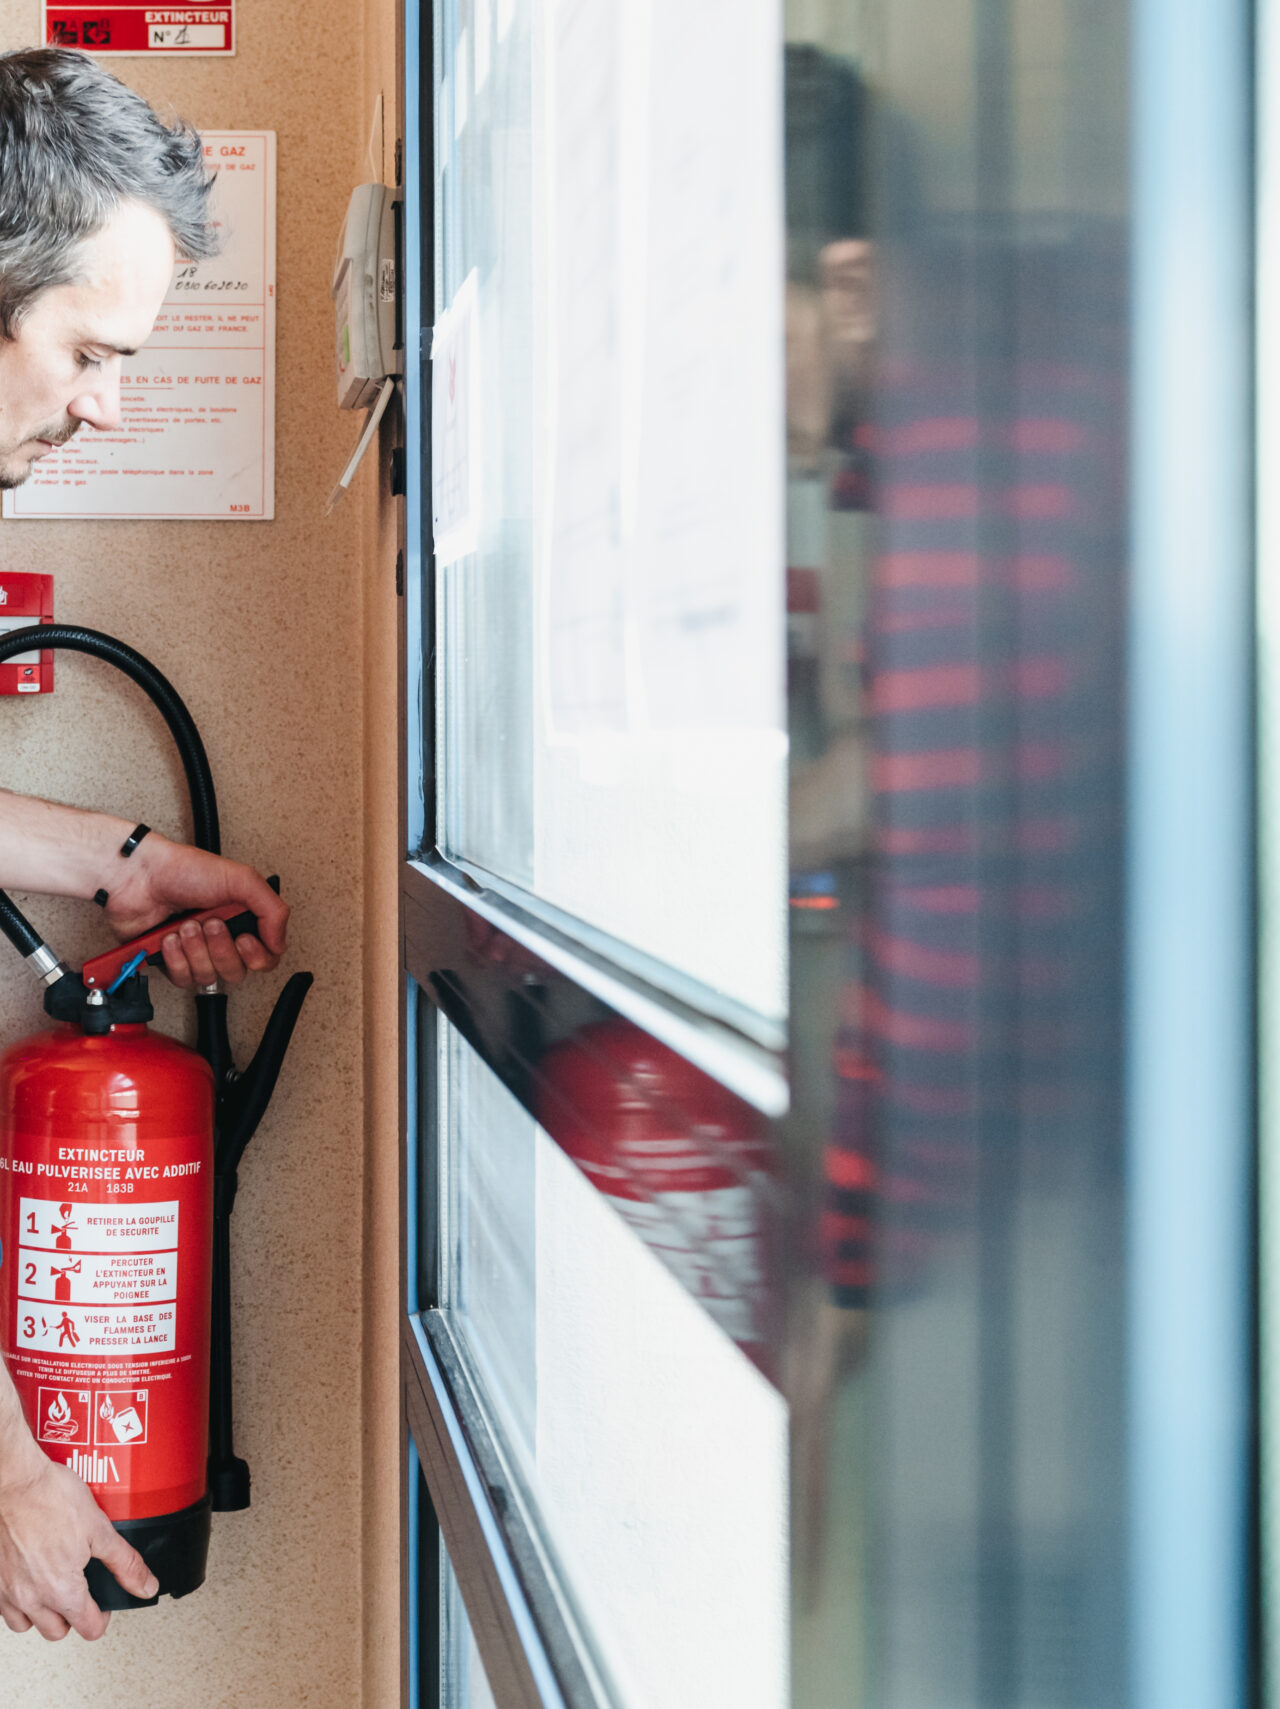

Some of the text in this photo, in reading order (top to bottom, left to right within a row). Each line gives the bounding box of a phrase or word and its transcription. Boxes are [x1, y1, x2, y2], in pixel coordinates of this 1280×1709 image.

[145, 11, 229, 23] EXTINCTEUR
[154, 31, 171, 43] N°
[220, 146, 246, 157] GAZ
[177, 266, 198, 278] 18
[120, 376, 262, 384] ES EN CAS DE FUITE DE GAZ
[230, 504, 250, 513] M3B
[58, 1147, 145, 1162] EXTINCTEUR
[0, 1157, 201, 1180] 6L EAU PULVERISEE AVEC ADDITIF
[67, 1182, 134, 1194] 21A 183B
[26, 1212, 39, 1235] 1
[87, 1215, 175, 1226] RETIRER LA GOUPILLE
[106, 1227, 160, 1237] DE SECURITE
[111, 1257, 154, 1267] PERCUTER
[24, 1262, 37, 1286] 2
[96, 1267, 166, 1278] L'EXTINCTEUR EN
[92, 1278, 168, 1289] APPUYANT SUR LA
[113, 1290, 150, 1300] POIGNEE
[84, 1312, 173, 1324] VISER LA BASE DES
[23, 1315, 36, 1339] 3
[103, 1325, 157, 1335] FLAMMES ET
[89, 1334, 168, 1345] PRESSER LA LANCE
[32, 1358, 69, 1367] INSTALLATION
[70, 1362, 106, 1370] ELECTRIQUE
[125, 1361, 149, 1369] TENSION
[38, 1366, 53, 1374] TENIR
[48, 1374, 73, 1382] CONTACT
